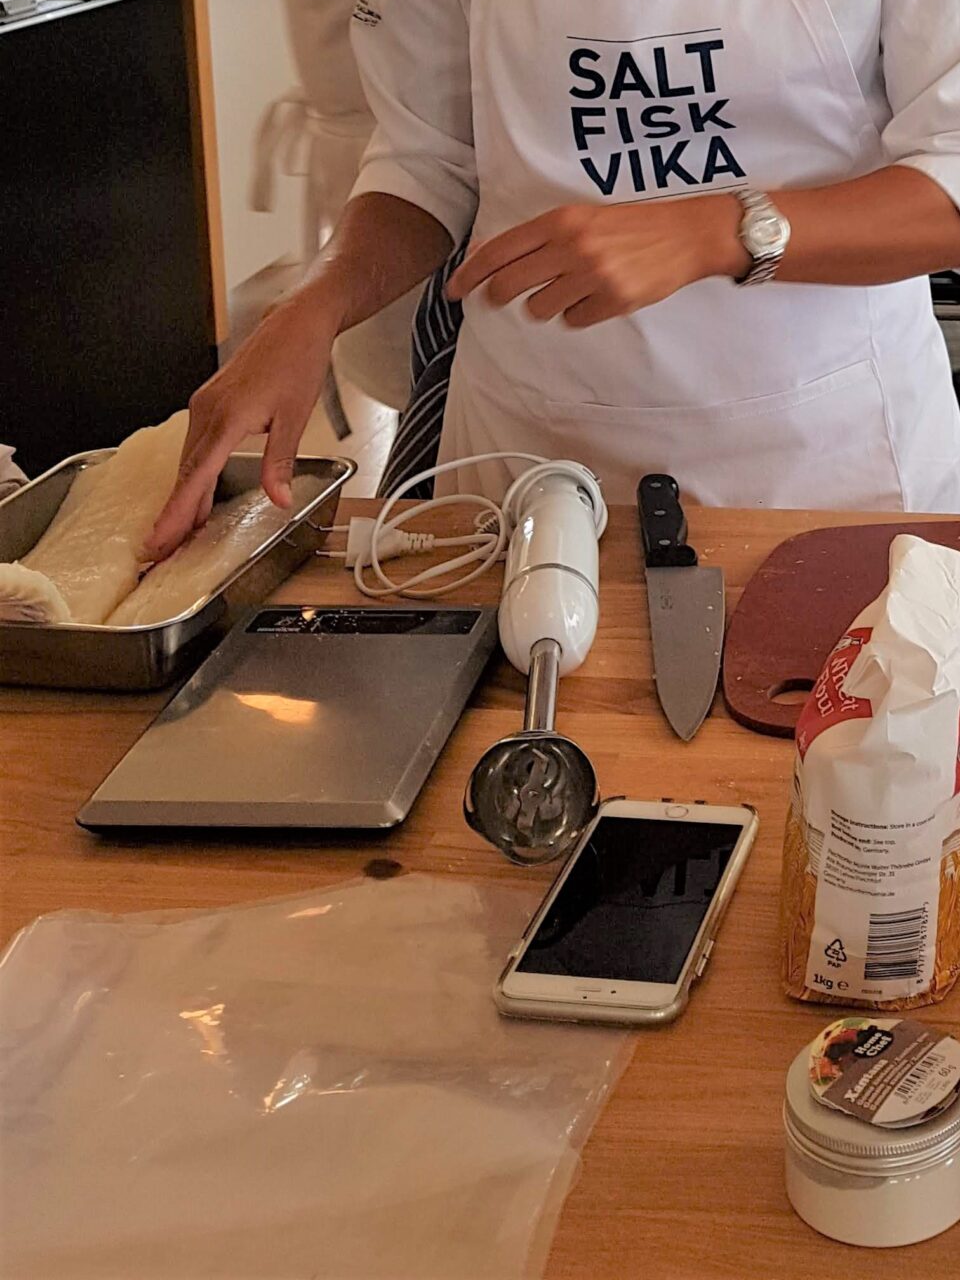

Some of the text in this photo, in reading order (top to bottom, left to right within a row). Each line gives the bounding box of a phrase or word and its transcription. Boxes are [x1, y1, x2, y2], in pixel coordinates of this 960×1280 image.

[569, 39, 724, 99] SALT
[571, 98, 737, 151] FISK
[580, 135, 747, 196] VIKA
[828, 960, 842, 968] PAP
[813, 973, 834, 990] 1kg
[854, 1032, 882, 1054] Home
[866, 1035, 892, 1056] Chef
